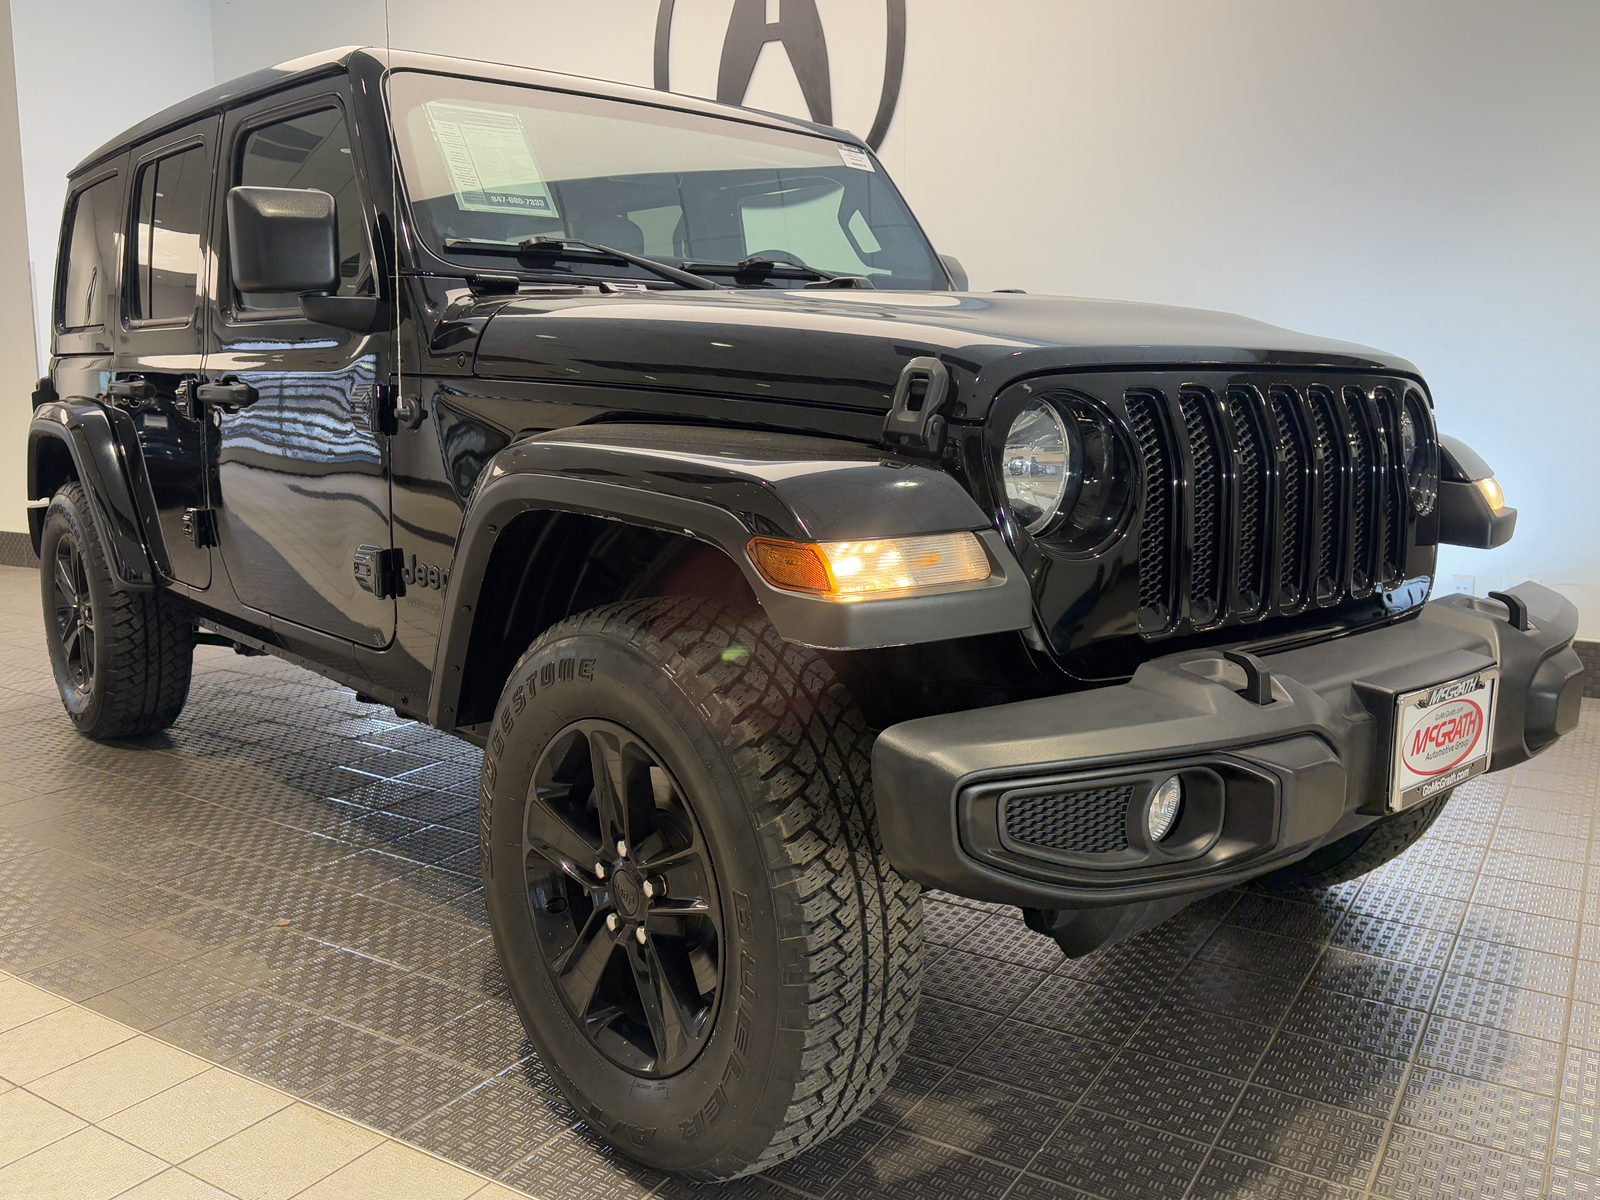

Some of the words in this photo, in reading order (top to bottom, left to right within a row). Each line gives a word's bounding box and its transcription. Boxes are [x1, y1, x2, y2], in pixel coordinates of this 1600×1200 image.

[1424, 744, 1455, 762] Automotive
[1454, 738, 1470, 752] Group
[1421, 768, 1470, 797] GoMcGrath.com
